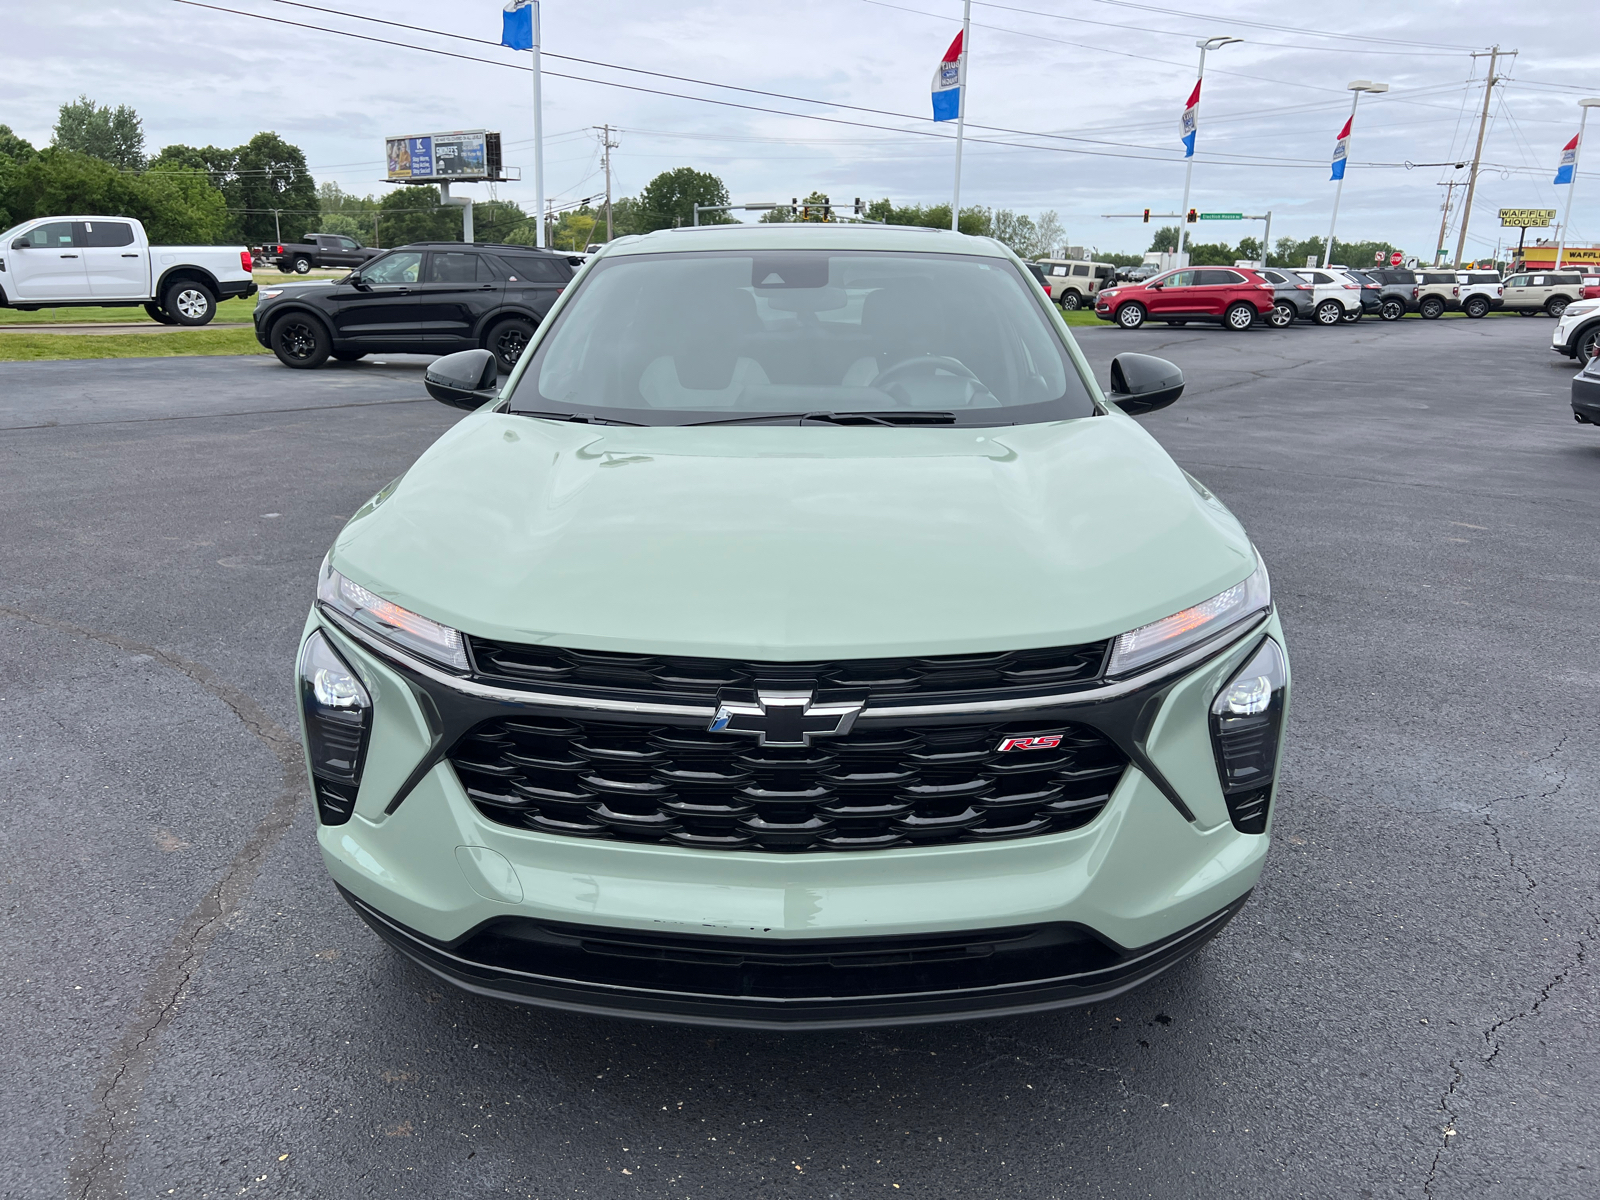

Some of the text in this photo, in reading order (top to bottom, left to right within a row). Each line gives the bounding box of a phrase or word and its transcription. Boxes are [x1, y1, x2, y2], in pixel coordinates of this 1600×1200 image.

[416, 139, 423, 149] K
[1501, 210, 1554, 218] WAFFLE
[997, 734, 1064, 751] RS
